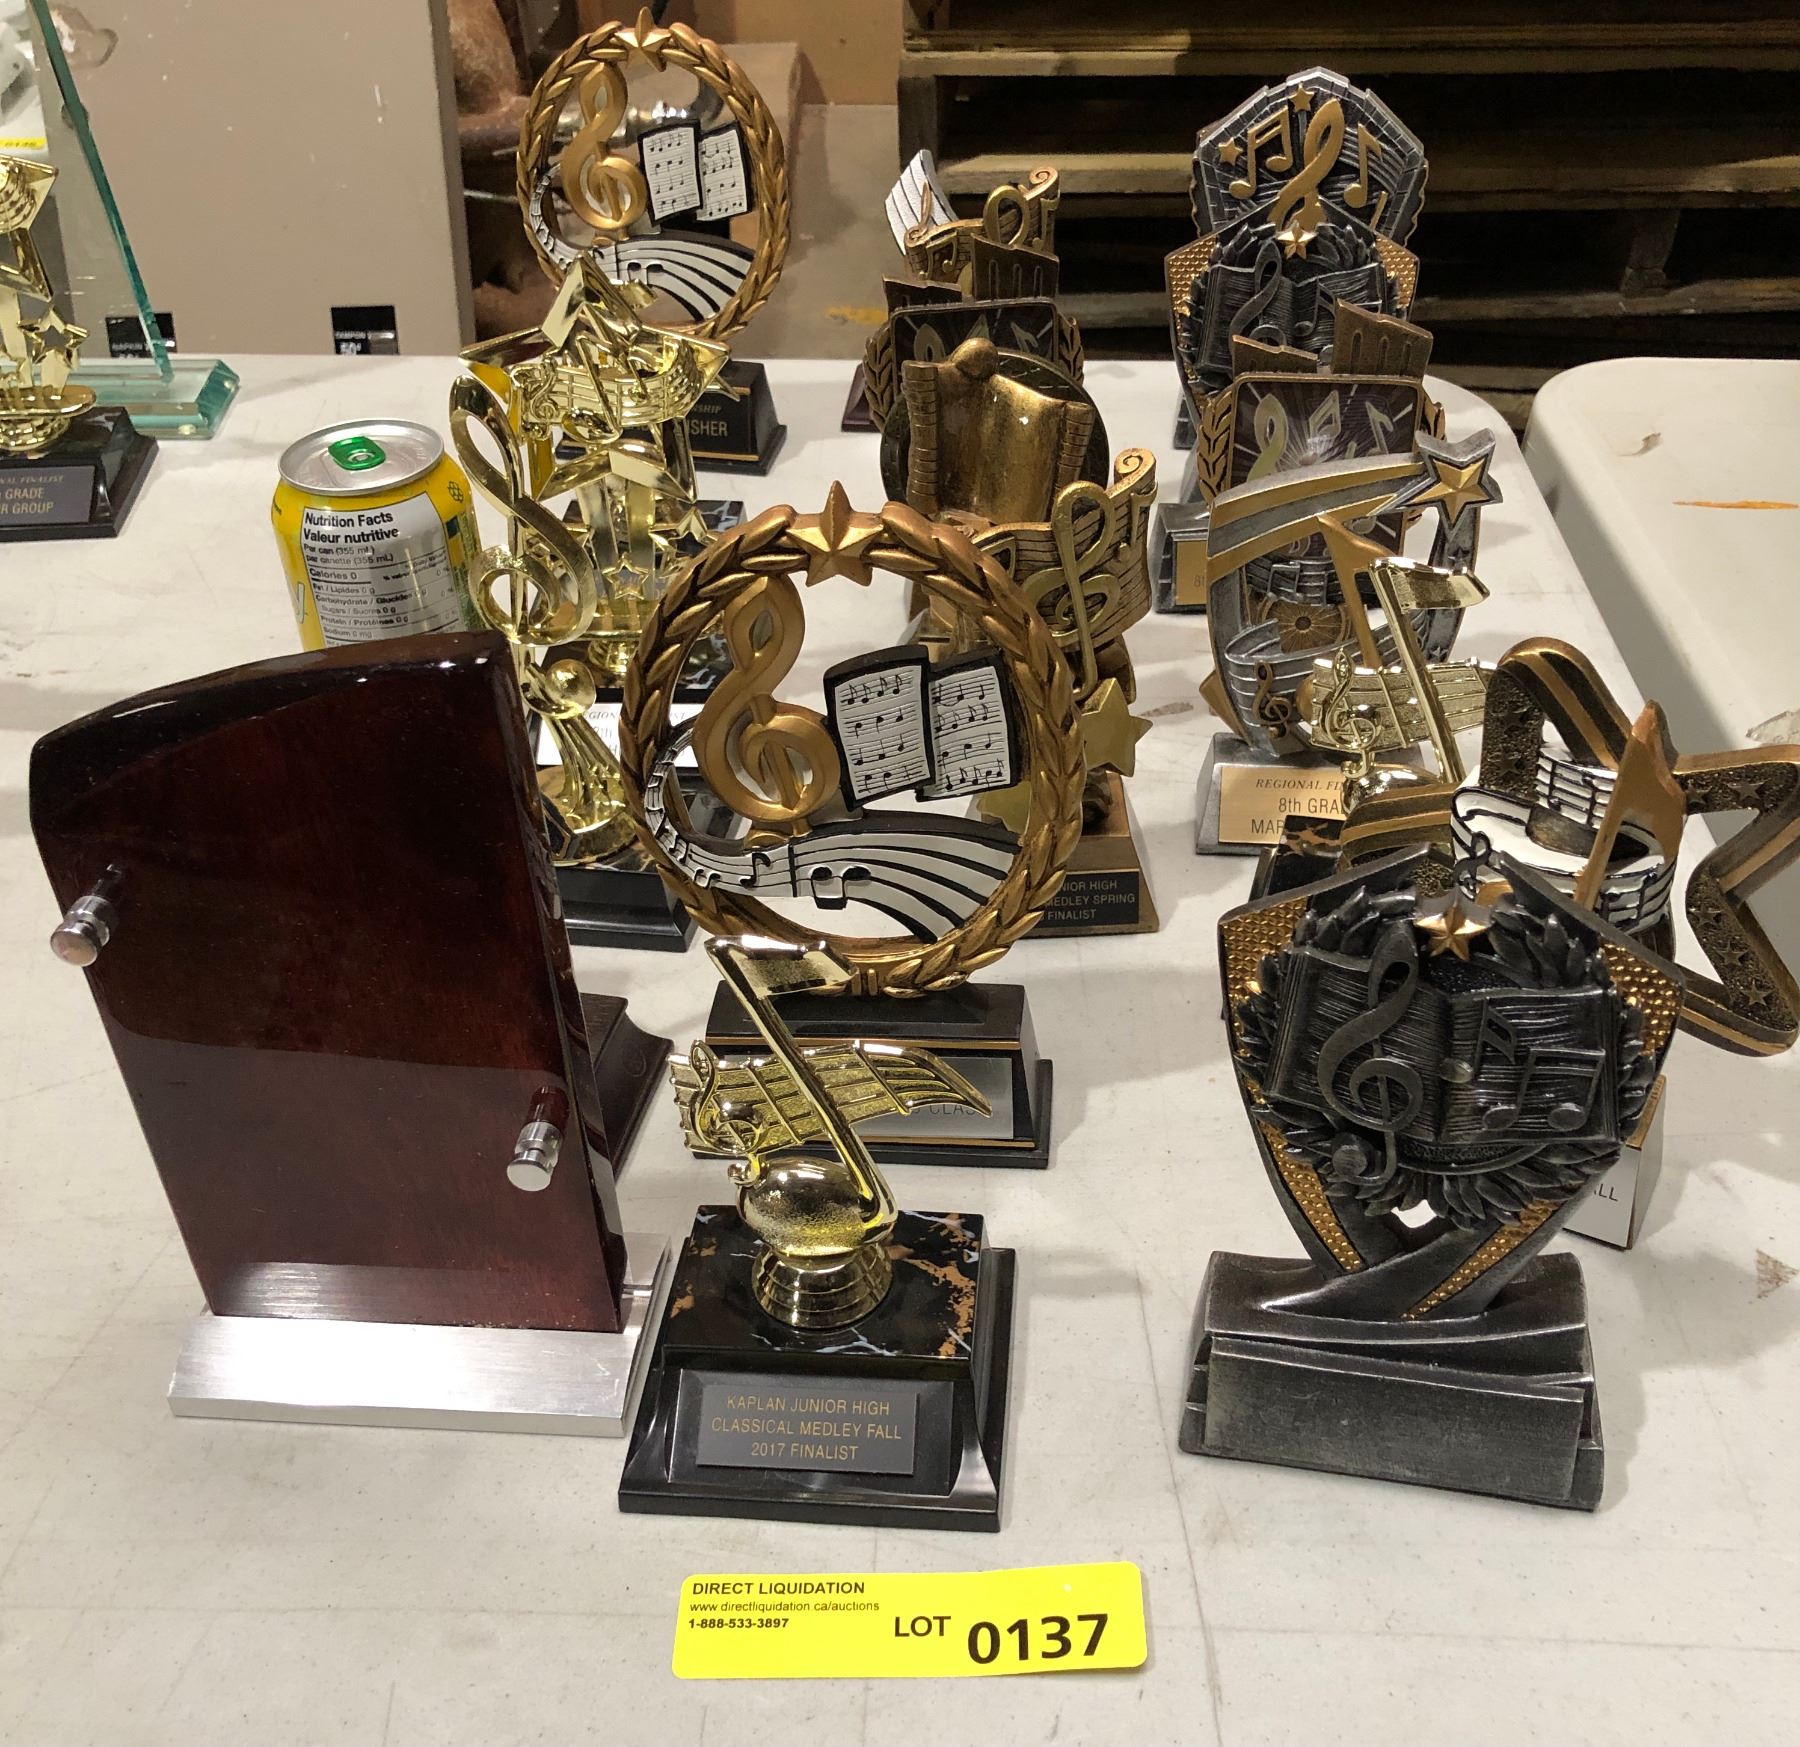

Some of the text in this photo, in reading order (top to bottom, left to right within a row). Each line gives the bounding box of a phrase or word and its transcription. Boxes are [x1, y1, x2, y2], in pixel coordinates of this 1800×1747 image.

[5, 486, 45, 500] GRADE
[12, 500, 54, 514] GROUP
[304, 511, 394, 528] Nutrition Facts
[303, 527, 400, 544] Valeur nutritive
[335, 546, 355, 557] (355
[309, 568, 348, 580] Calories
[330, 586, 360, 595] Lipides
[315, 594, 369, 606] Carbohydrate
[1255, 778, 1323, 790] REGIONAL
[1278, 797, 1344, 815] 8th GRA
[1089, 879, 1118, 891] HIGH
[1092, 892, 1136, 905] SPRING
[1047, 908, 1097, 921] FINALIST
[727, 1396, 890, 1416] KAPLAN JUNIOR HIGH
[711, 1417, 903, 1440] CLASSICAL MEDLEY FALL
[751, 1442, 859, 1460] 2017 FINALIST
[692, 1581, 866, 1595] DIRECT LIQUIDATION
[688, 1618, 790, 1629] 1-888-533-3897
[894, 1612, 1109, 1665] LOT 0137
